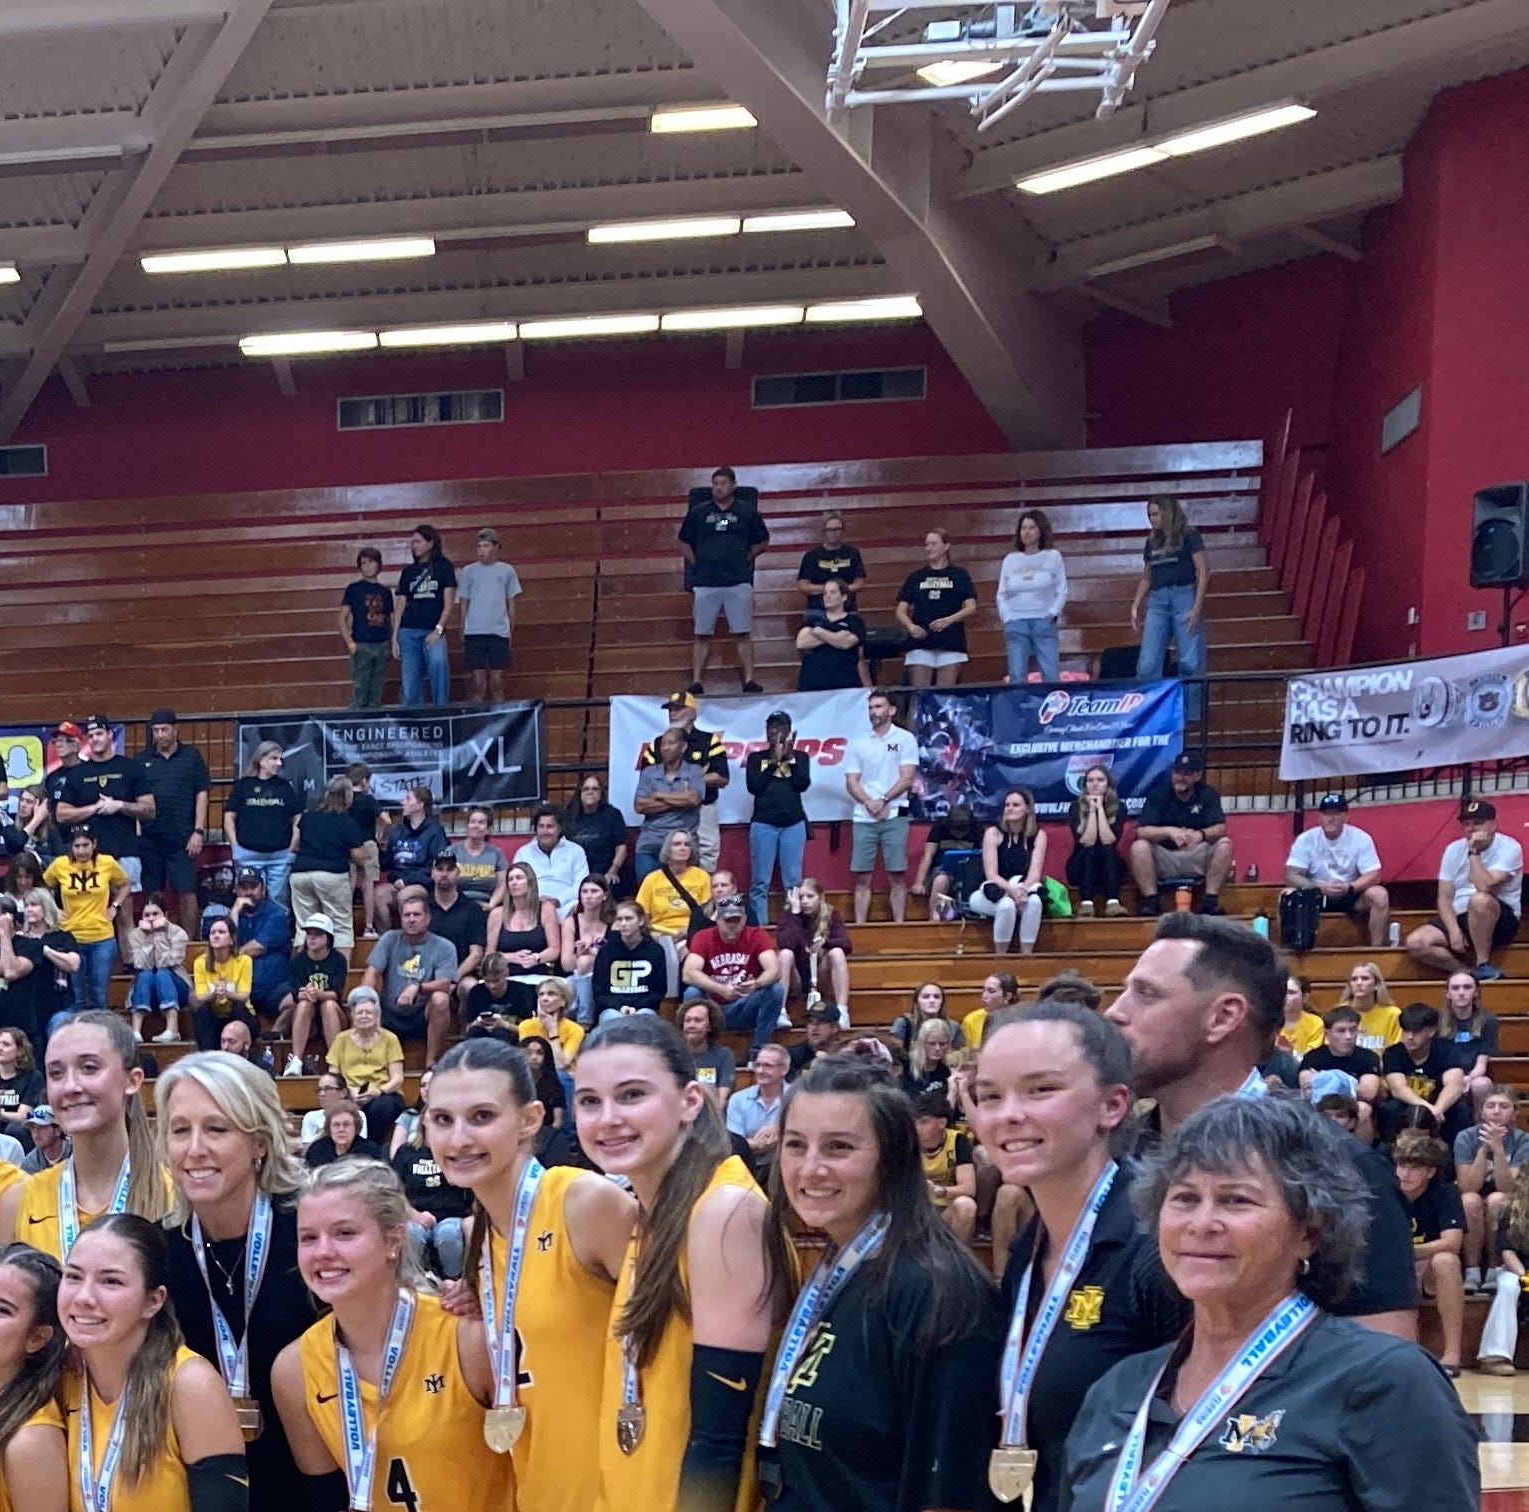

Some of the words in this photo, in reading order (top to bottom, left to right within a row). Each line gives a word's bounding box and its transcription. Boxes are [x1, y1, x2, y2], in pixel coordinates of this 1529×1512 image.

[1290, 670, 1414, 701] CHAMPION
[1290, 700, 1338, 724] HAS
[1340, 701, 1360, 720] A
[1290, 722, 1342, 745] RING
[1348, 717, 1381, 740] TO
[1385, 713, 1411, 736] IT.
[332, 726, 444, 741] ENGINEERED
[1010, 742, 1059, 754] EXCLUSIVE
[1059, 738, 1132, 752] MERCHANDISER
[1132, 735, 1152, 747] FOR
[1153, 734, 1170, 746] THE
[467, 736, 522, 777] XL
[610, 960, 652, 986] GP
[504, 1247, 520, 1334] VOLLEYBALL
[780, 1284, 820, 1372] VOLLEYBALL
[1017, 1295, 1059, 1395] VOLLEYBALL
[1241, 1296, 1309, 1368] OLLEYBALL
[342, 1368, 361, 1451] VOLLEYBALL
